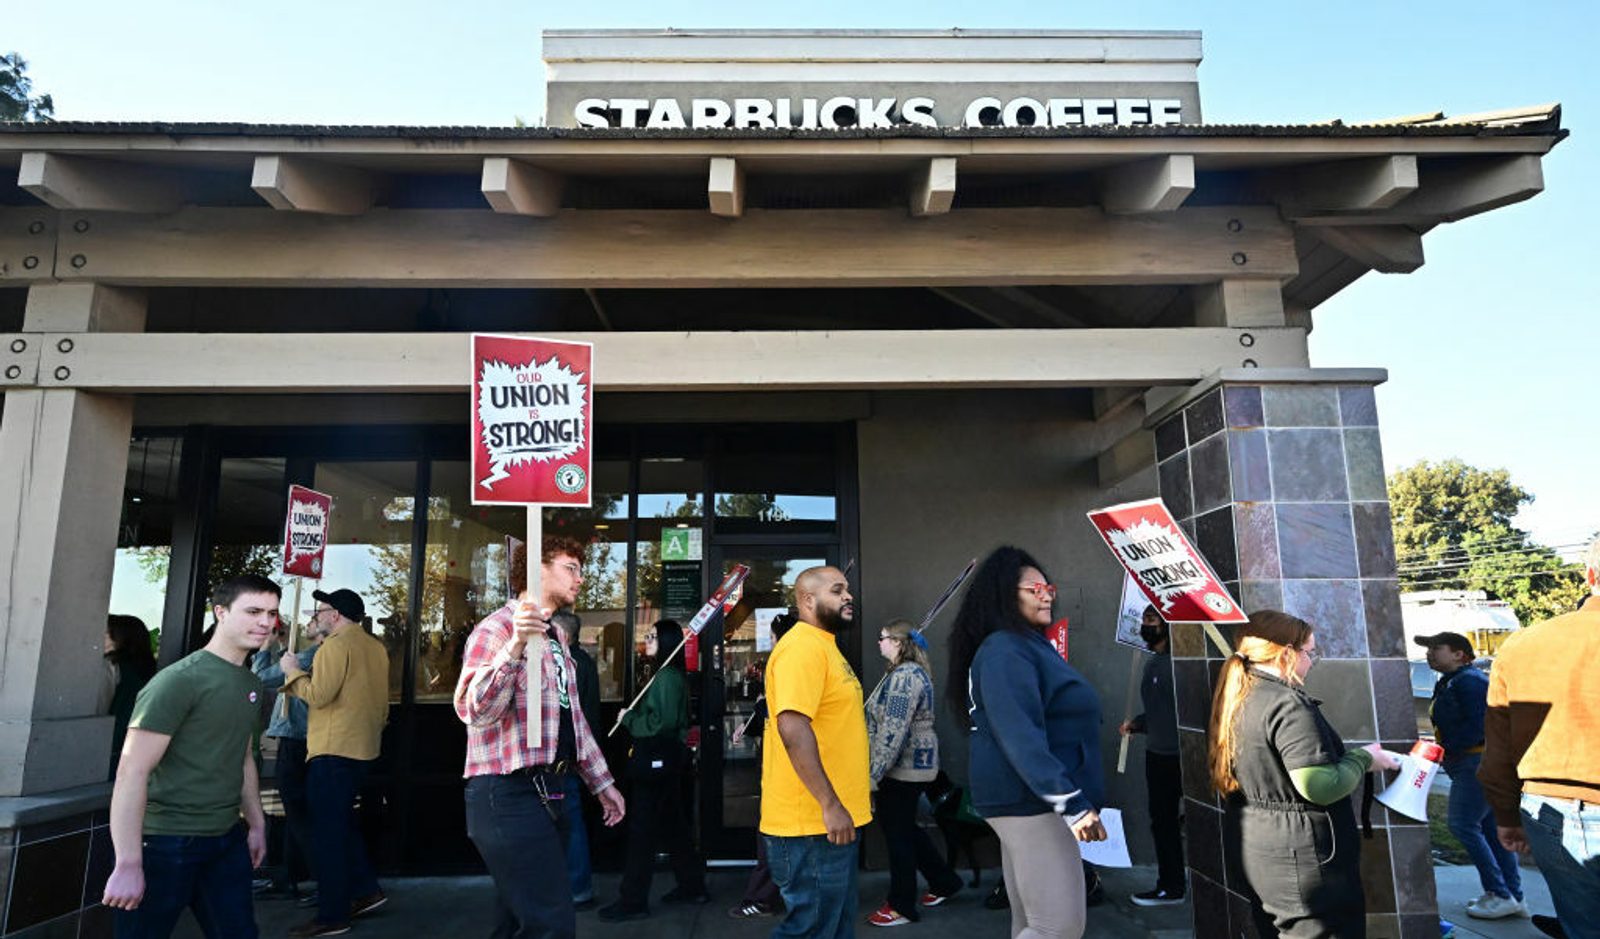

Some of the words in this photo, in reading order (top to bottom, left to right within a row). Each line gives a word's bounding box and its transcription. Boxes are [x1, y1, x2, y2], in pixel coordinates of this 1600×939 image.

[574, 97, 938, 129] STARBUCKS
[963, 96, 1182, 128] COFFEE
[517, 372, 542, 384] OUR
[490, 383, 570, 409] UNION
[528, 409, 540, 420] IS
[489, 418, 581, 448] STRONG!
[293, 512, 322, 526] UNION
[292, 532, 323, 547] STRONG!
[666, 535, 684, 555] A
[1121, 535, 1176, 561] UNION
[1140, 559, 1204, 587] STRONG!
